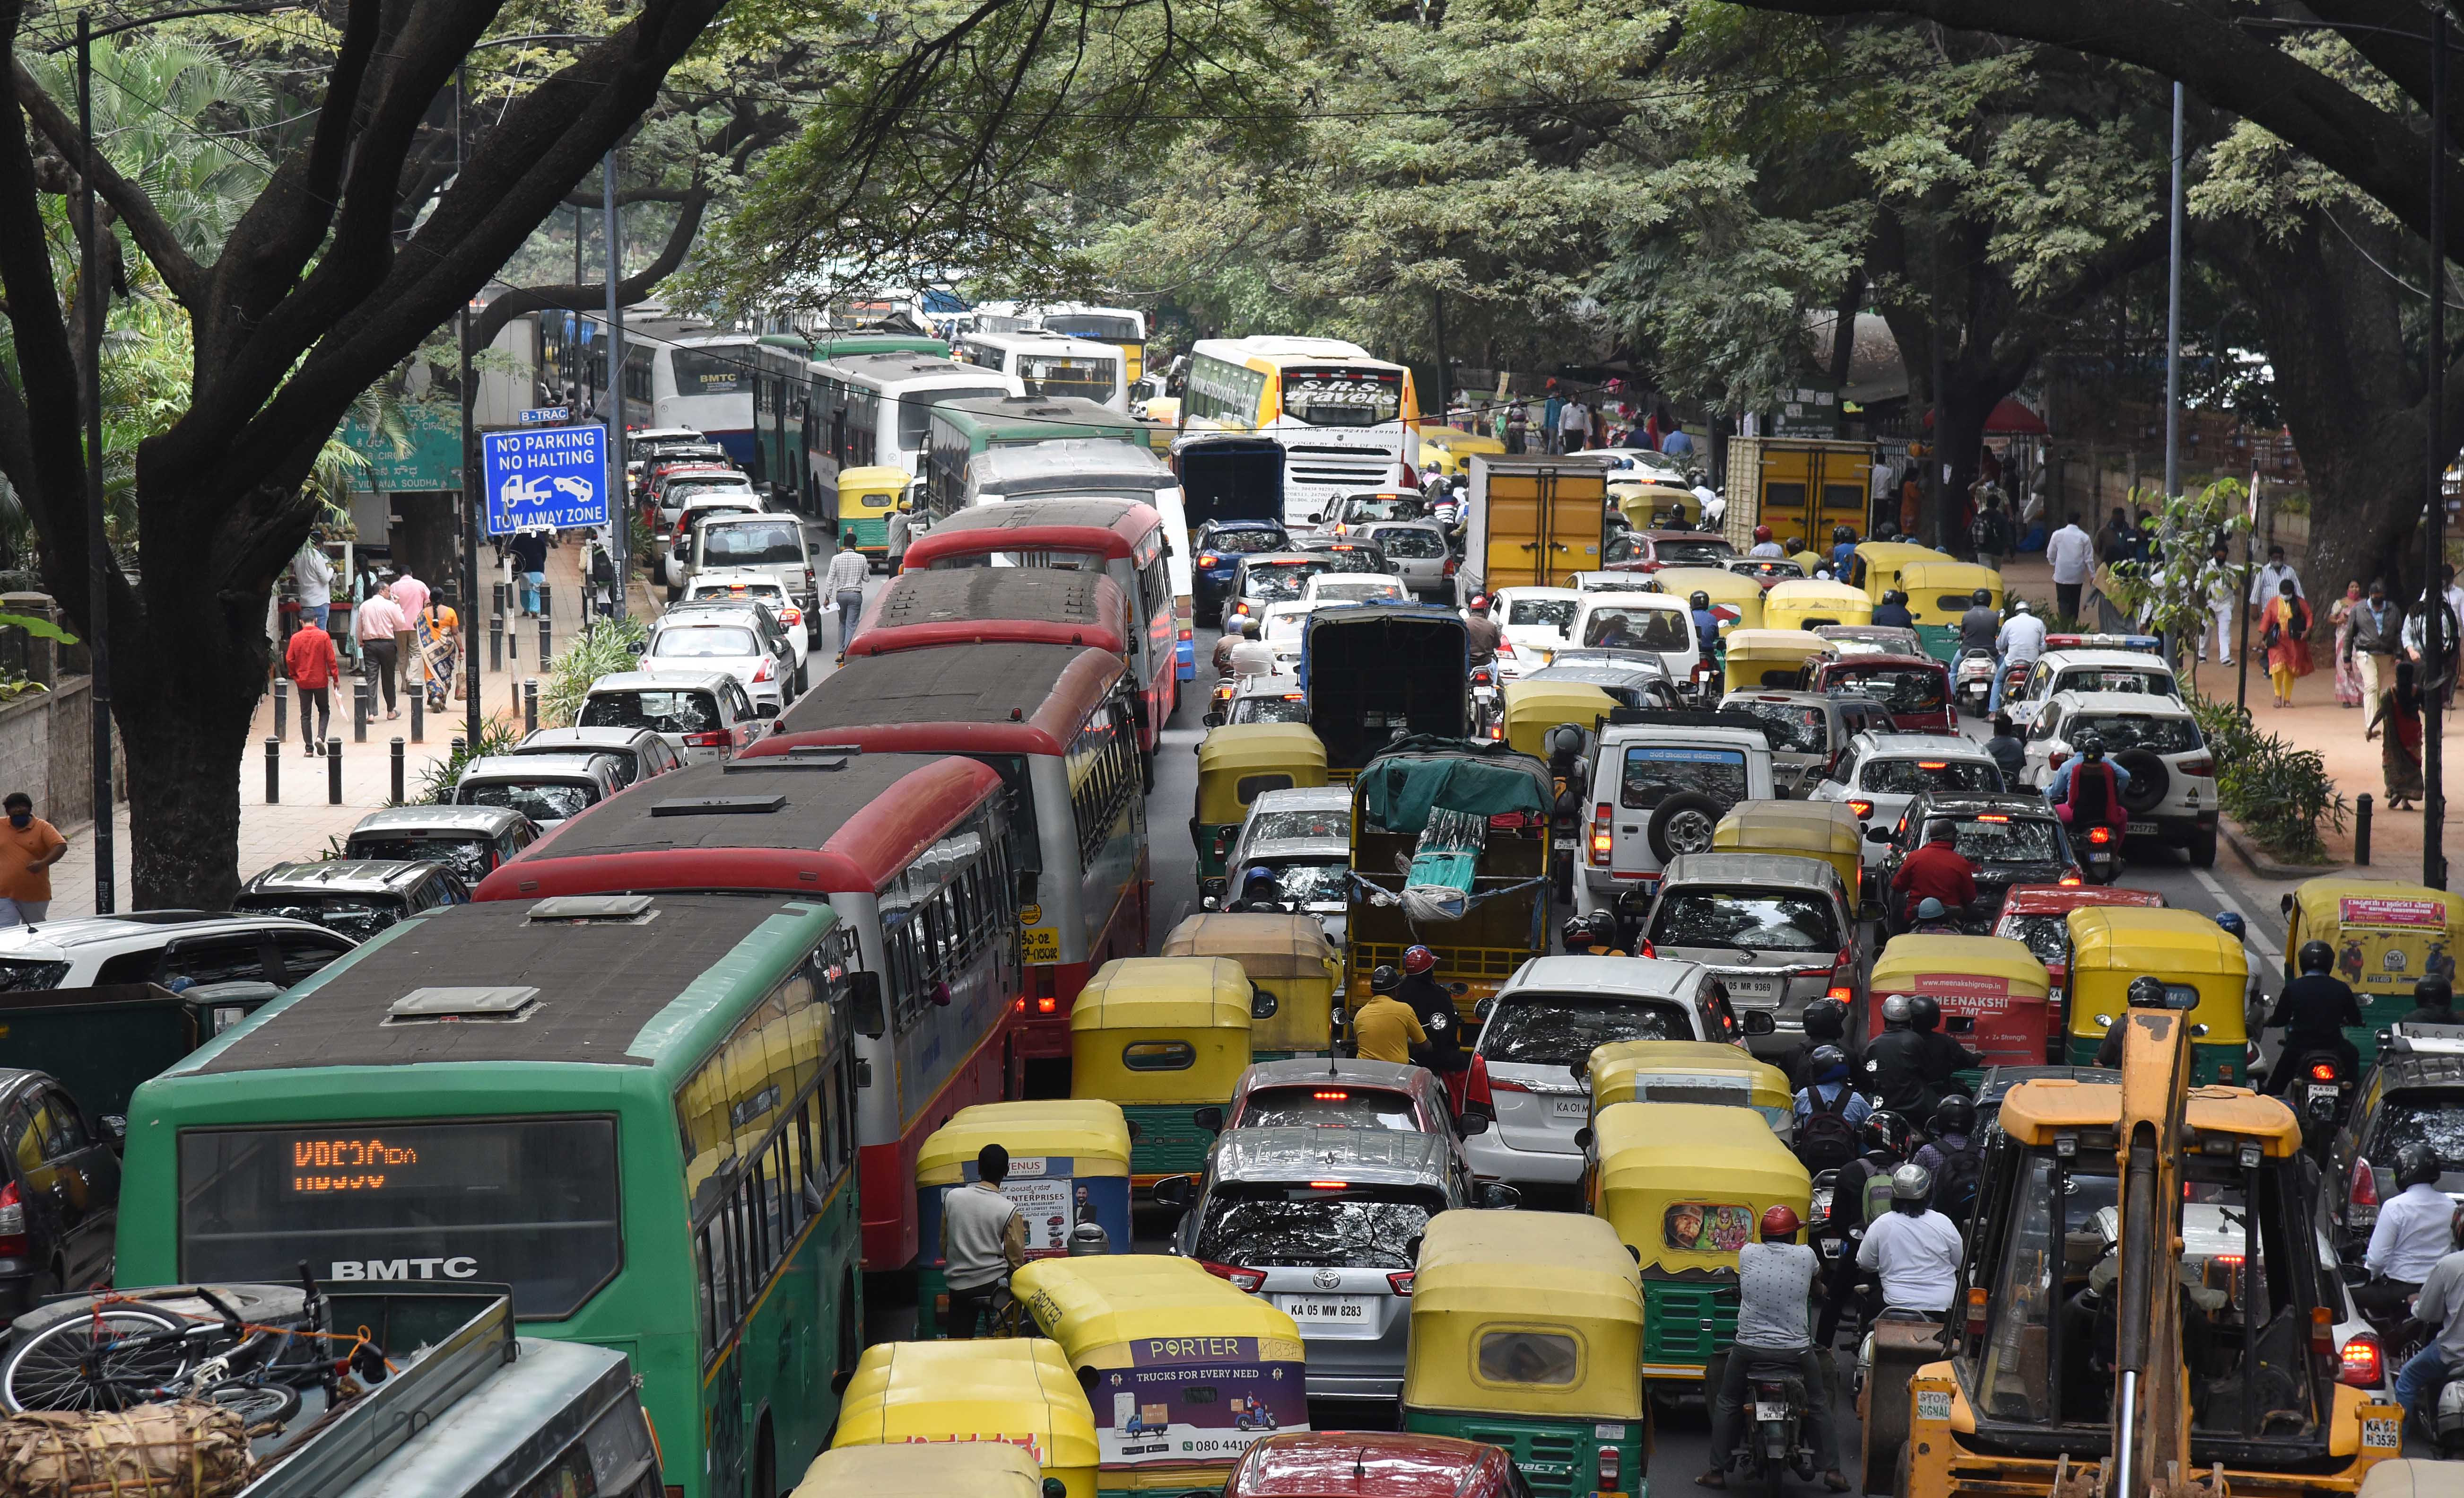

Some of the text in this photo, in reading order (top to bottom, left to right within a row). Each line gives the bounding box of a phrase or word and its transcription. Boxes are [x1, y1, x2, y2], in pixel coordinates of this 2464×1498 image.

[700, 374, 736, 382] BMTC
[1299, 380, 1383, 392] S.R.S.
[1191, 376, 1256, 411] www.srsbooking.com
[1286, 391, 1398, 404] travels
[522, 410, 567, 421] B-TRAC
[497, 432, 594, 453] NO PARKING
[499, 450, 594, 470] NO HALTING
[358, 479, 438, 489] VIDANA SOUDHA
[495, 506, 602, 528] TOW AWAY ZONE
[1755, 983, 1771, 991] 9369
[1923, 980, 2001, 990] www.meenakshigroup.in
[1933, 996, 2008, 1008] MEENAKSHI
[1960, 1007, 1981, 1016] TMT
[2001, 1034, 2027, 1042] Strength
[1557, 1103, 1568, 1112] KA
[1571, 1103, 1579, 1112] 01
[1007, 1193, 1064, 1202] ENTERPRISES
[331, 1257, 478, 1281] BMTC
[1027, 1288, 1063, 1330] PORTER
[1291, 1305, 1361, 1316] KA 05 MW 8283
[1150, 1338, 1239, 1358] PORTER
[1136, 1369, 1259, 1382] TRUCKS FOR EVERY NEED
[1919, 1405, 1949, 1418] SIGNAL
[2367, 1420, 2380, 1431] KA
[1196, 1440, 1219, 1452] 080
[2376, 1435, 2397, 1446] 3539
